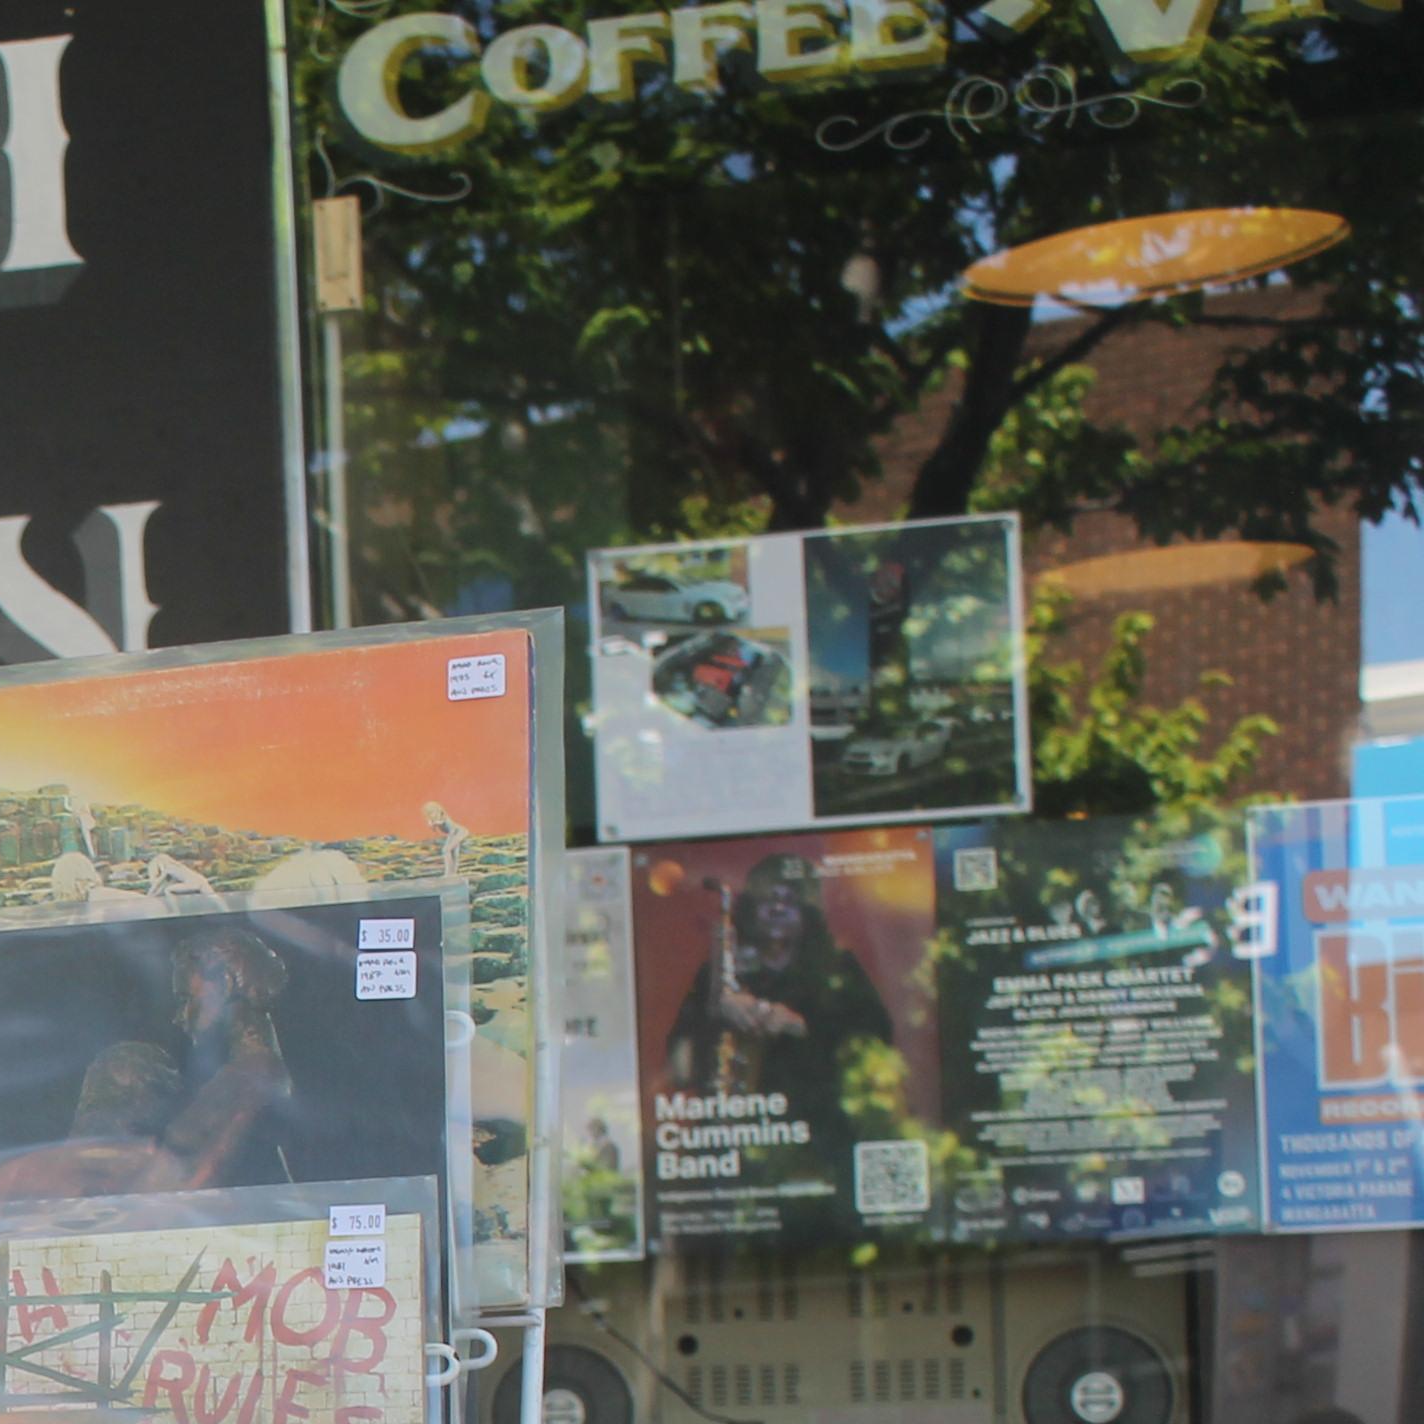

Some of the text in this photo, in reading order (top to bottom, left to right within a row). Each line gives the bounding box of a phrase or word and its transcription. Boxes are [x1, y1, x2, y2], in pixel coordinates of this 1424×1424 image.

[337, 0, 945, 150] COFFEE
[361, 928, 410, 943] $ 35.00
[655, 1092, 788, 1121] Marlene
[656, 1118, 811, 1150] Cummins
[657, 1149, 740, 1180] Band
[332, 1214, 381, 1229] $ 75.00
[196, 1257, 397, 1374] MOB
